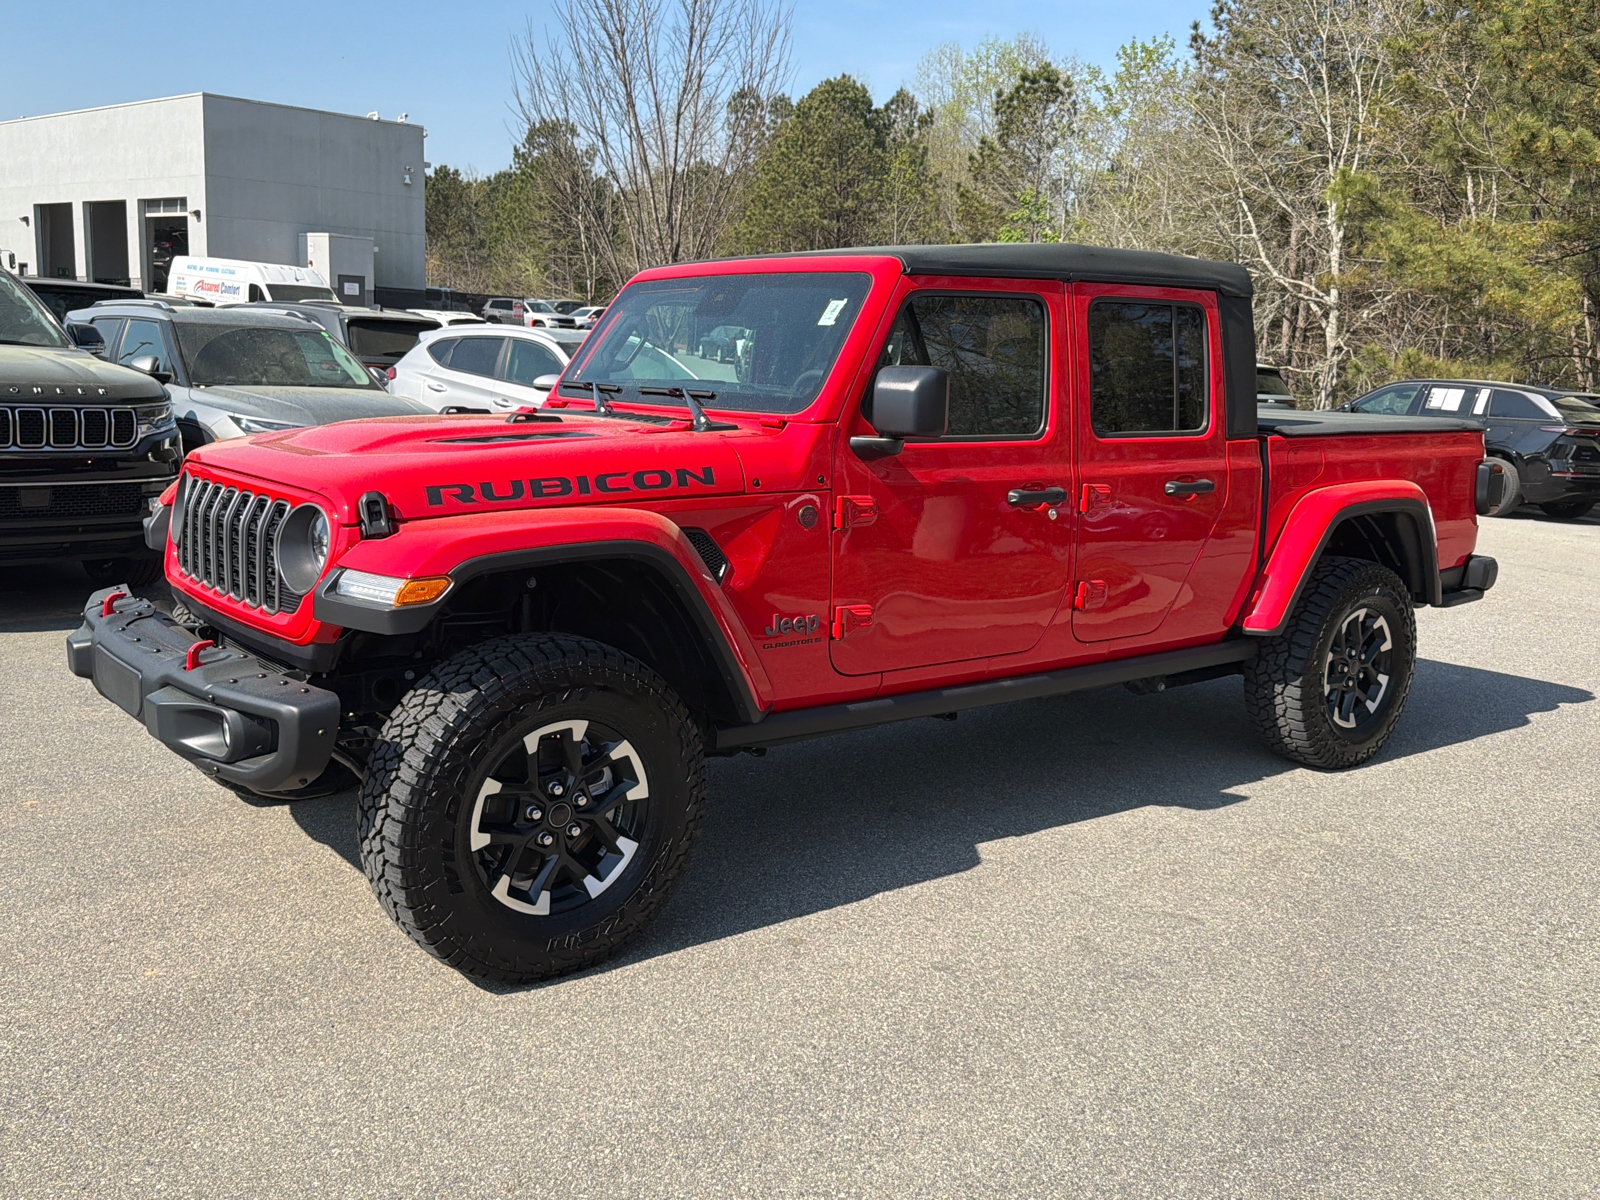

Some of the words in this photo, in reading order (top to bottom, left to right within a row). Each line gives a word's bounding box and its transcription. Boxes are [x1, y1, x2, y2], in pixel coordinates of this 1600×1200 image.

[200, 279, 220, 293] Assured
[221, 282, 240, 295] Comfort
[425, 467, 716, 506] RUBICON
[765, 613, 820, 636] Jeep
[763, 639, 813, 650] GLADIATOR
